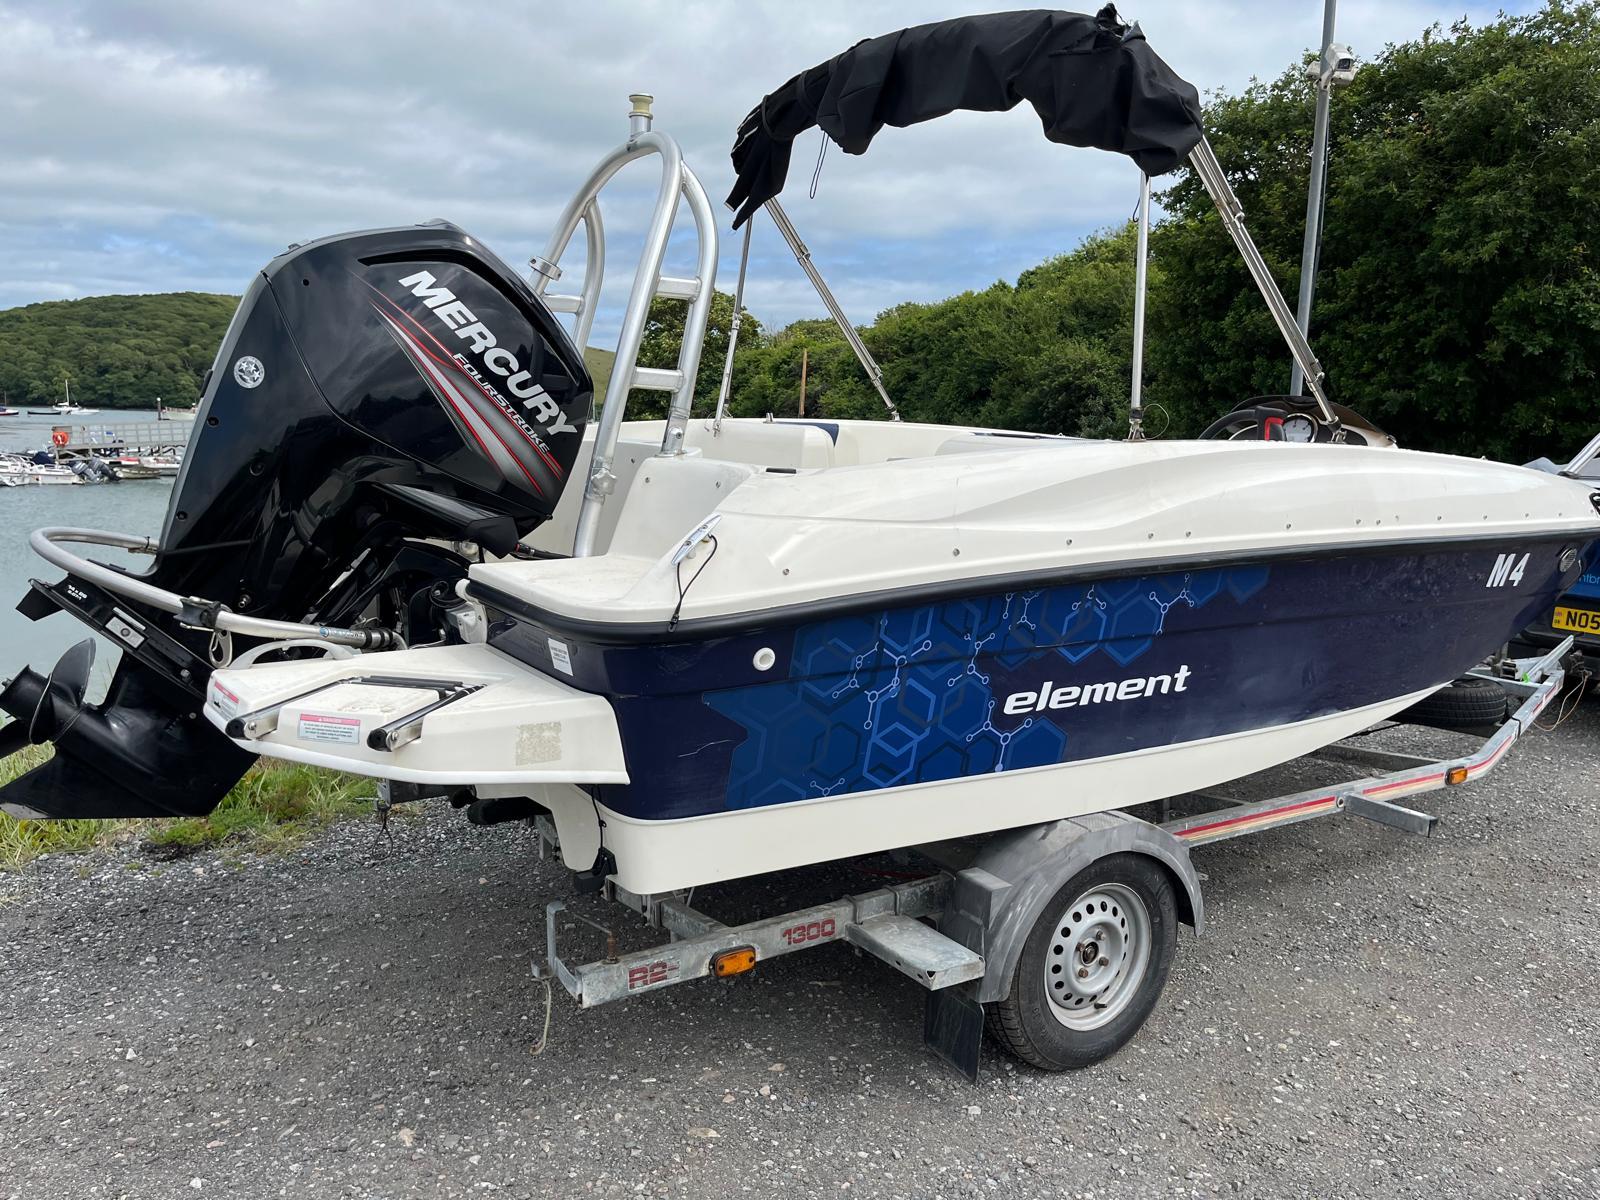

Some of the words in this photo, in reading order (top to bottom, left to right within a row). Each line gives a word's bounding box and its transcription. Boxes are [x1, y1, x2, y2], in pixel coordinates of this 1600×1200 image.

[398, 270, 578, 436] MERCURY
[452, 352, 550, 454] FOURSTROKE
[1485, 552, 1531, 588] M4
[1003, 664, 1192, 715] element
[782, 917, 836, 946] 1300
